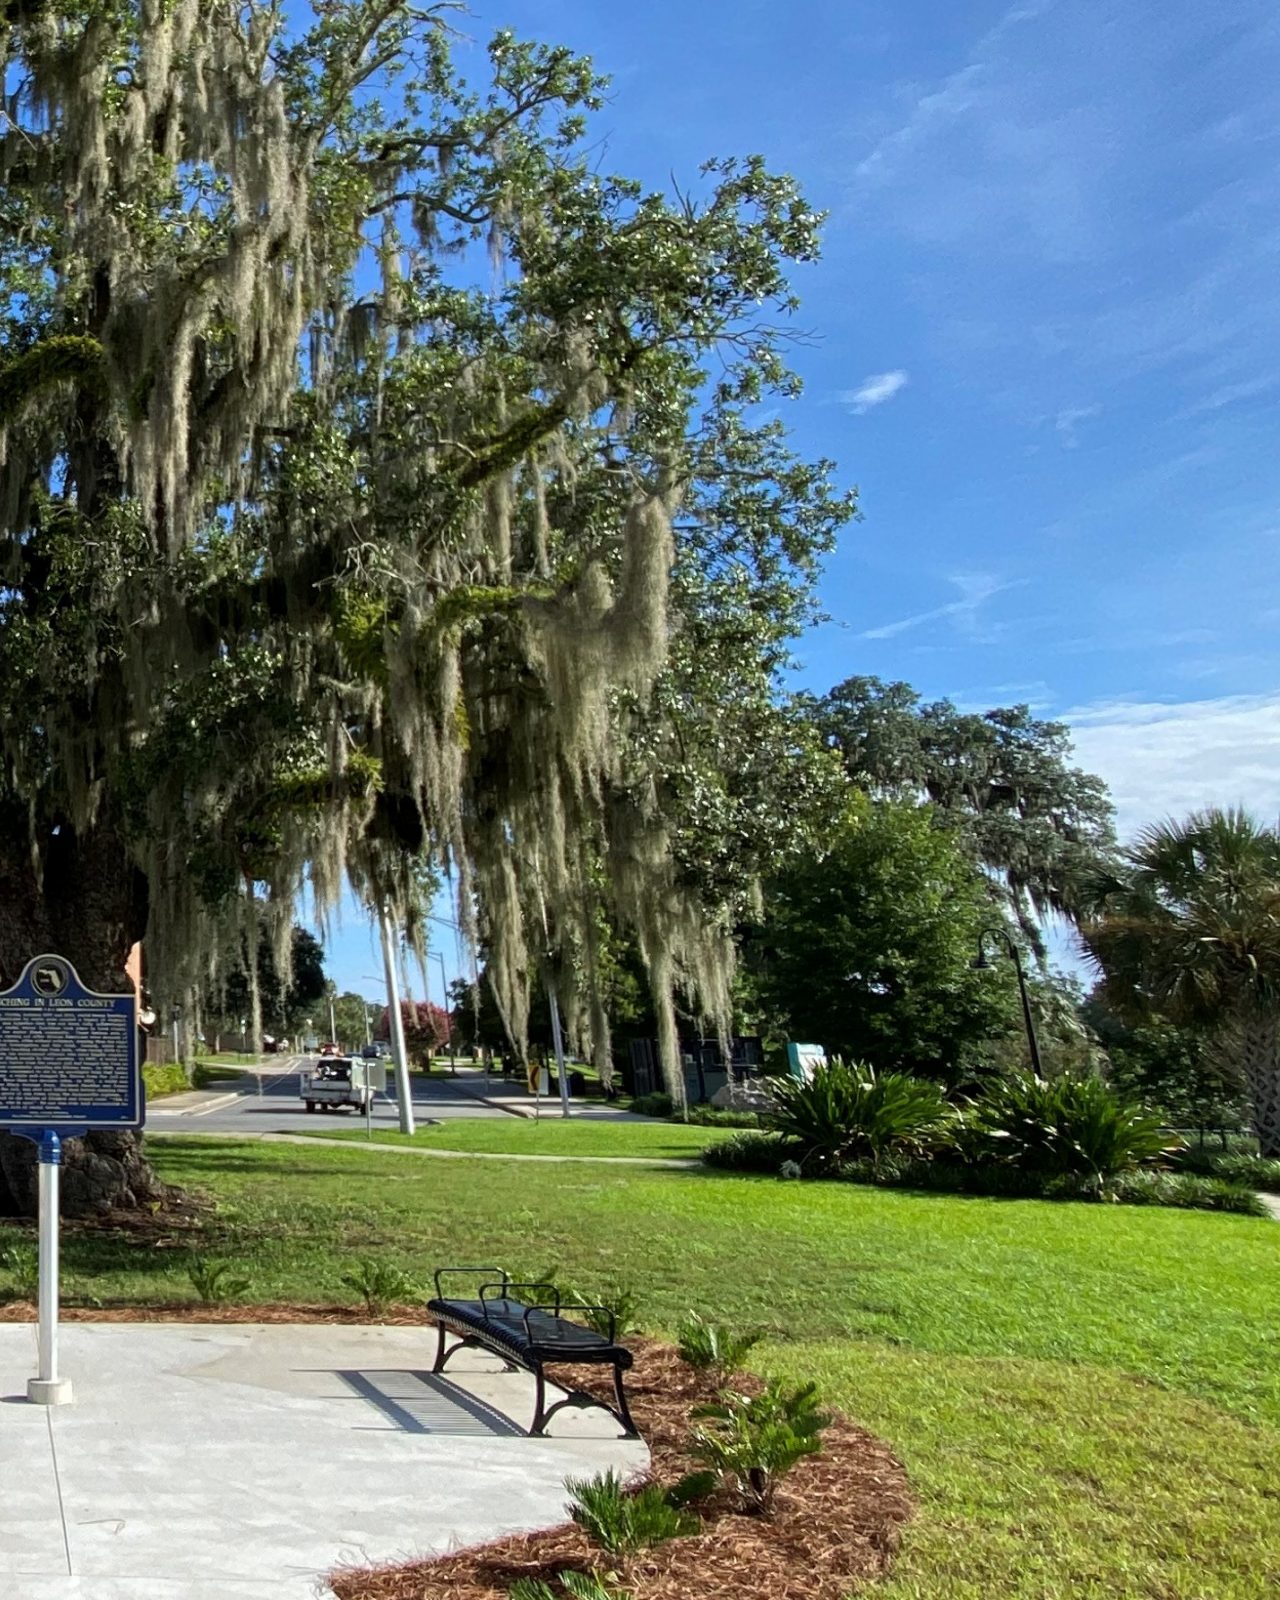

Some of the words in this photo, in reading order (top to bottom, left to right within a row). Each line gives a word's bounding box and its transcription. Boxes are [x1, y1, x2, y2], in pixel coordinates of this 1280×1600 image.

[34, 998, 45, 1007] IN
[49, 998, 73, 1007] LEON
[77, 999, 116, 1007] COUNTY
